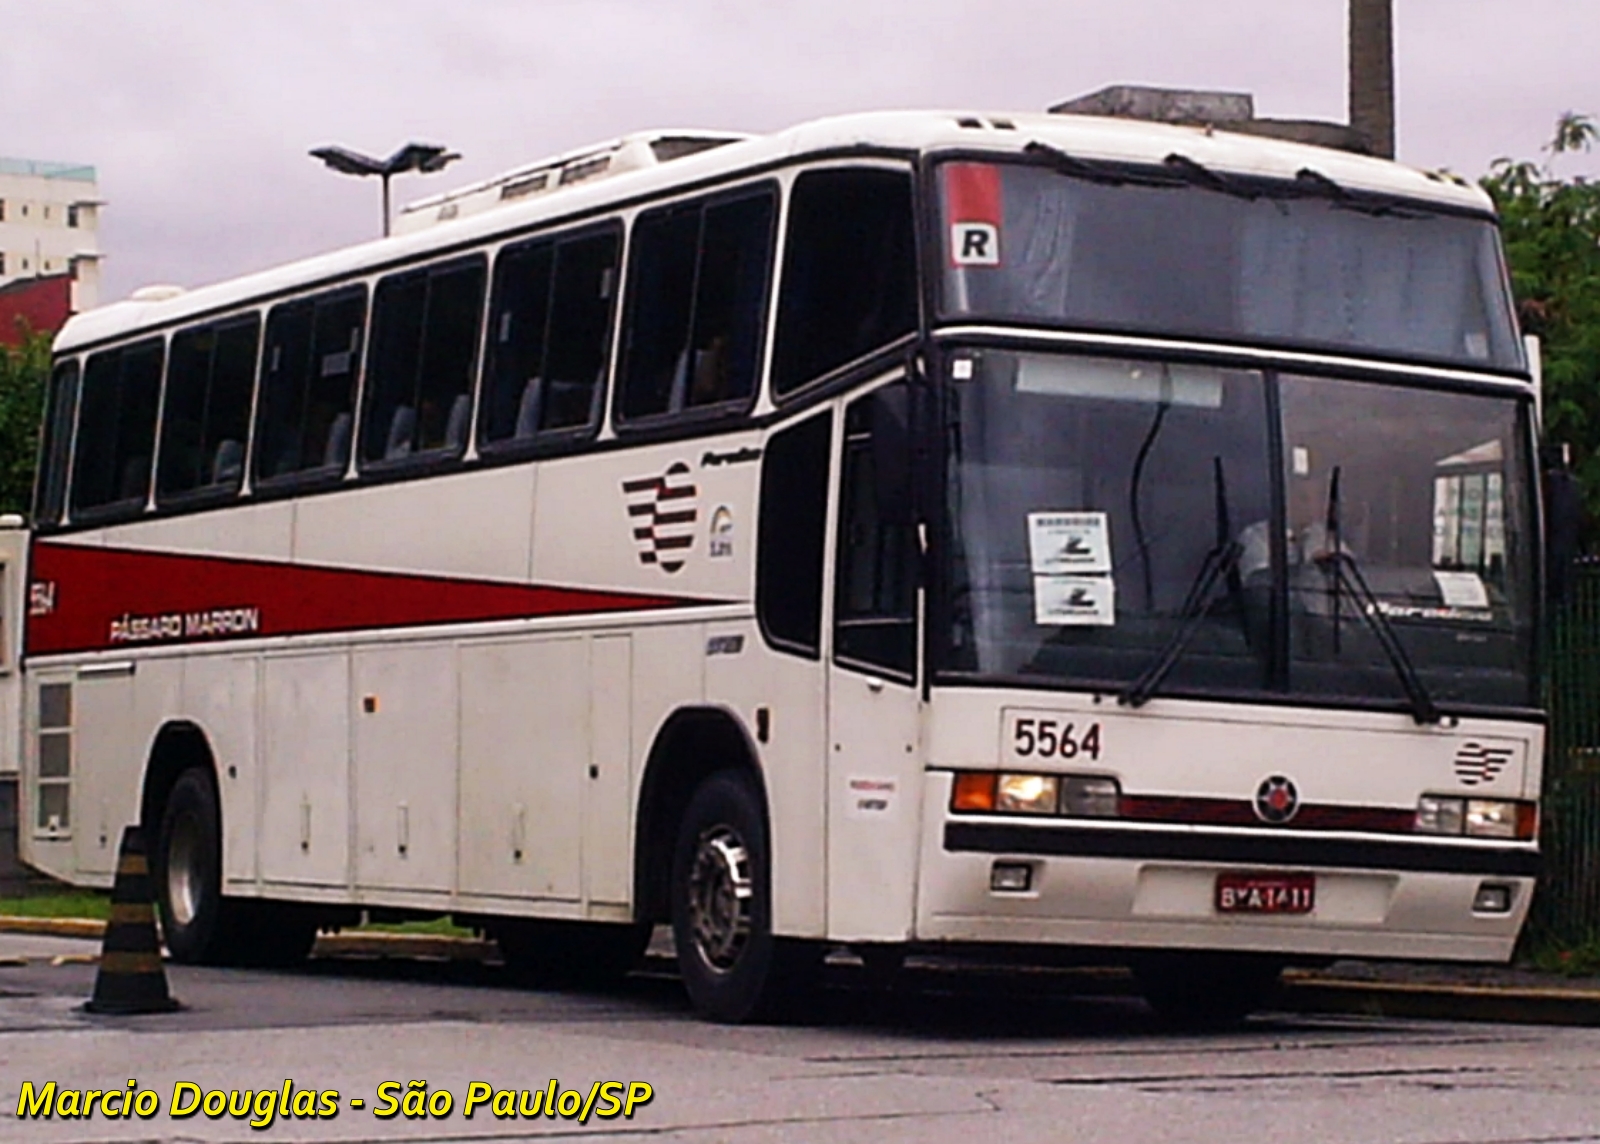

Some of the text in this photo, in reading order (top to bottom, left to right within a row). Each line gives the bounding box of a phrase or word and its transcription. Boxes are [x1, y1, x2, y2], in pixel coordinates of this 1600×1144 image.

[962, 229, 990, 257] R
[185, 608, 260, 635] MARRON
[1014, 718, 1102, 761] 5564
